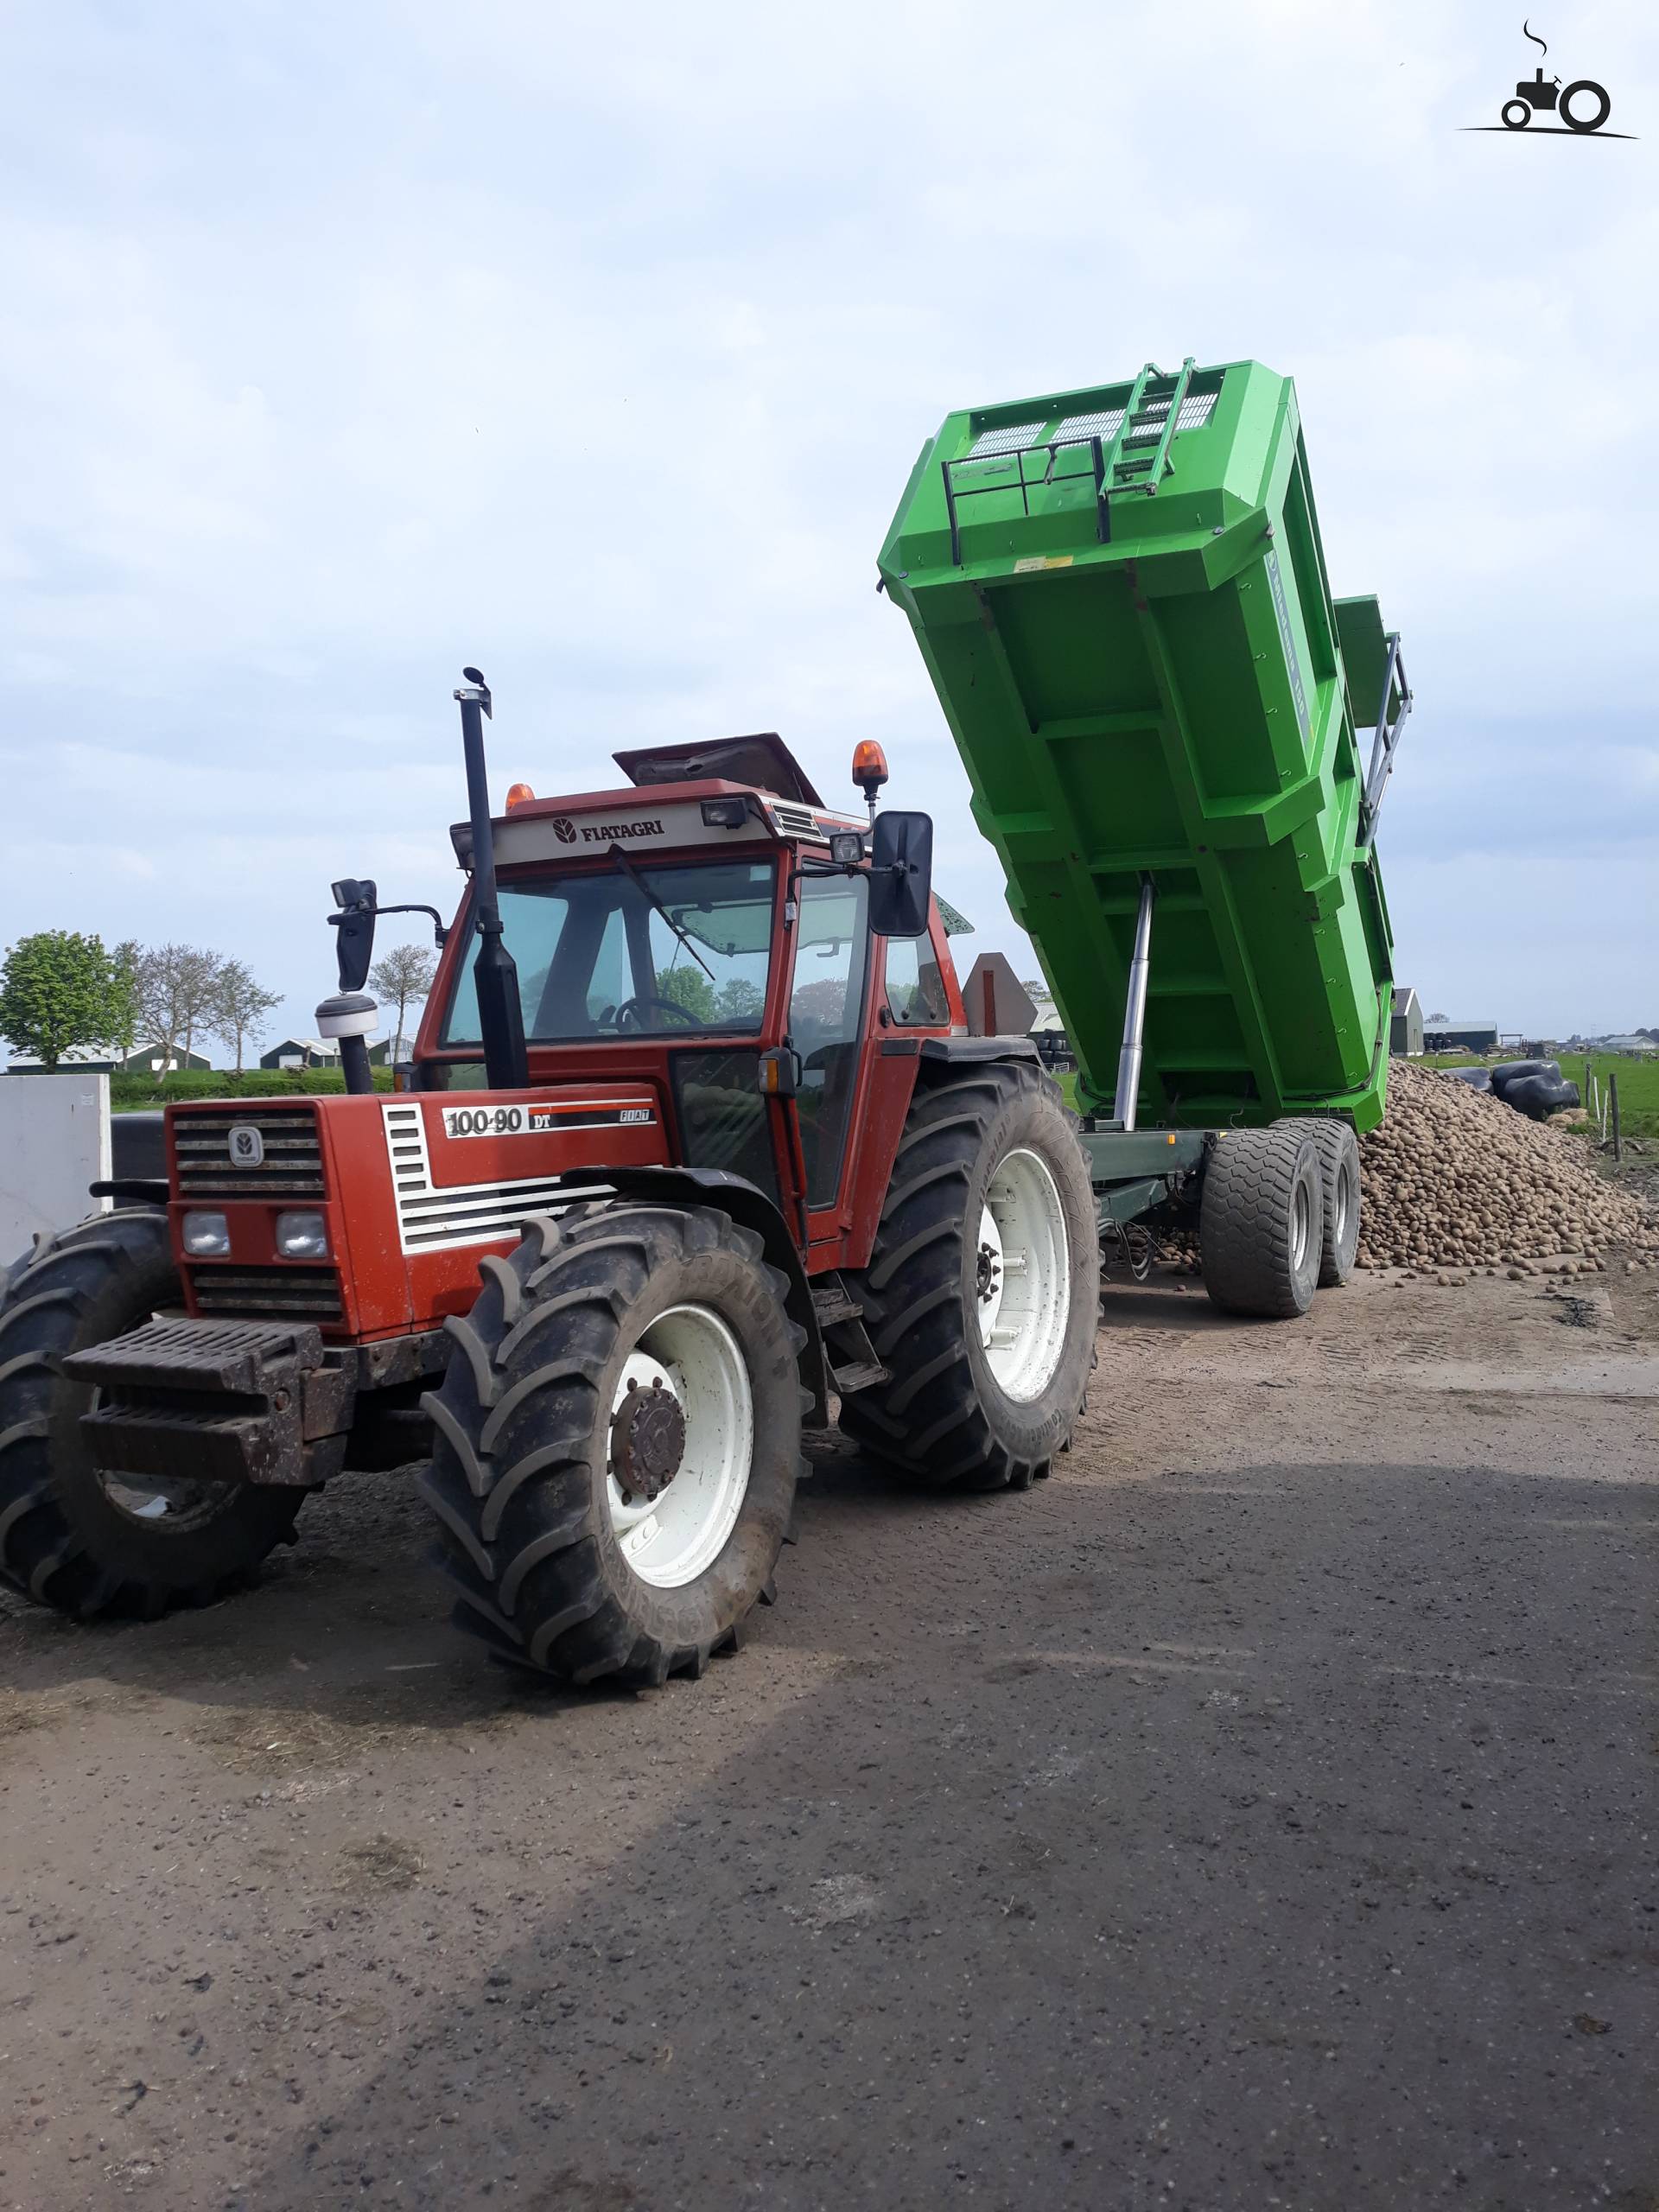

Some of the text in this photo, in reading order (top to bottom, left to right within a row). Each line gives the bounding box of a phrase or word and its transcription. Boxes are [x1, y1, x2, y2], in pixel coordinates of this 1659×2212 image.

[580, 820, 665, 842] FIATAGRI
[446, 1108, 522, 1137] 100-90
[533, 1114, 551, 1128] DT
[620, 1109, 650, 1122] FIAT
